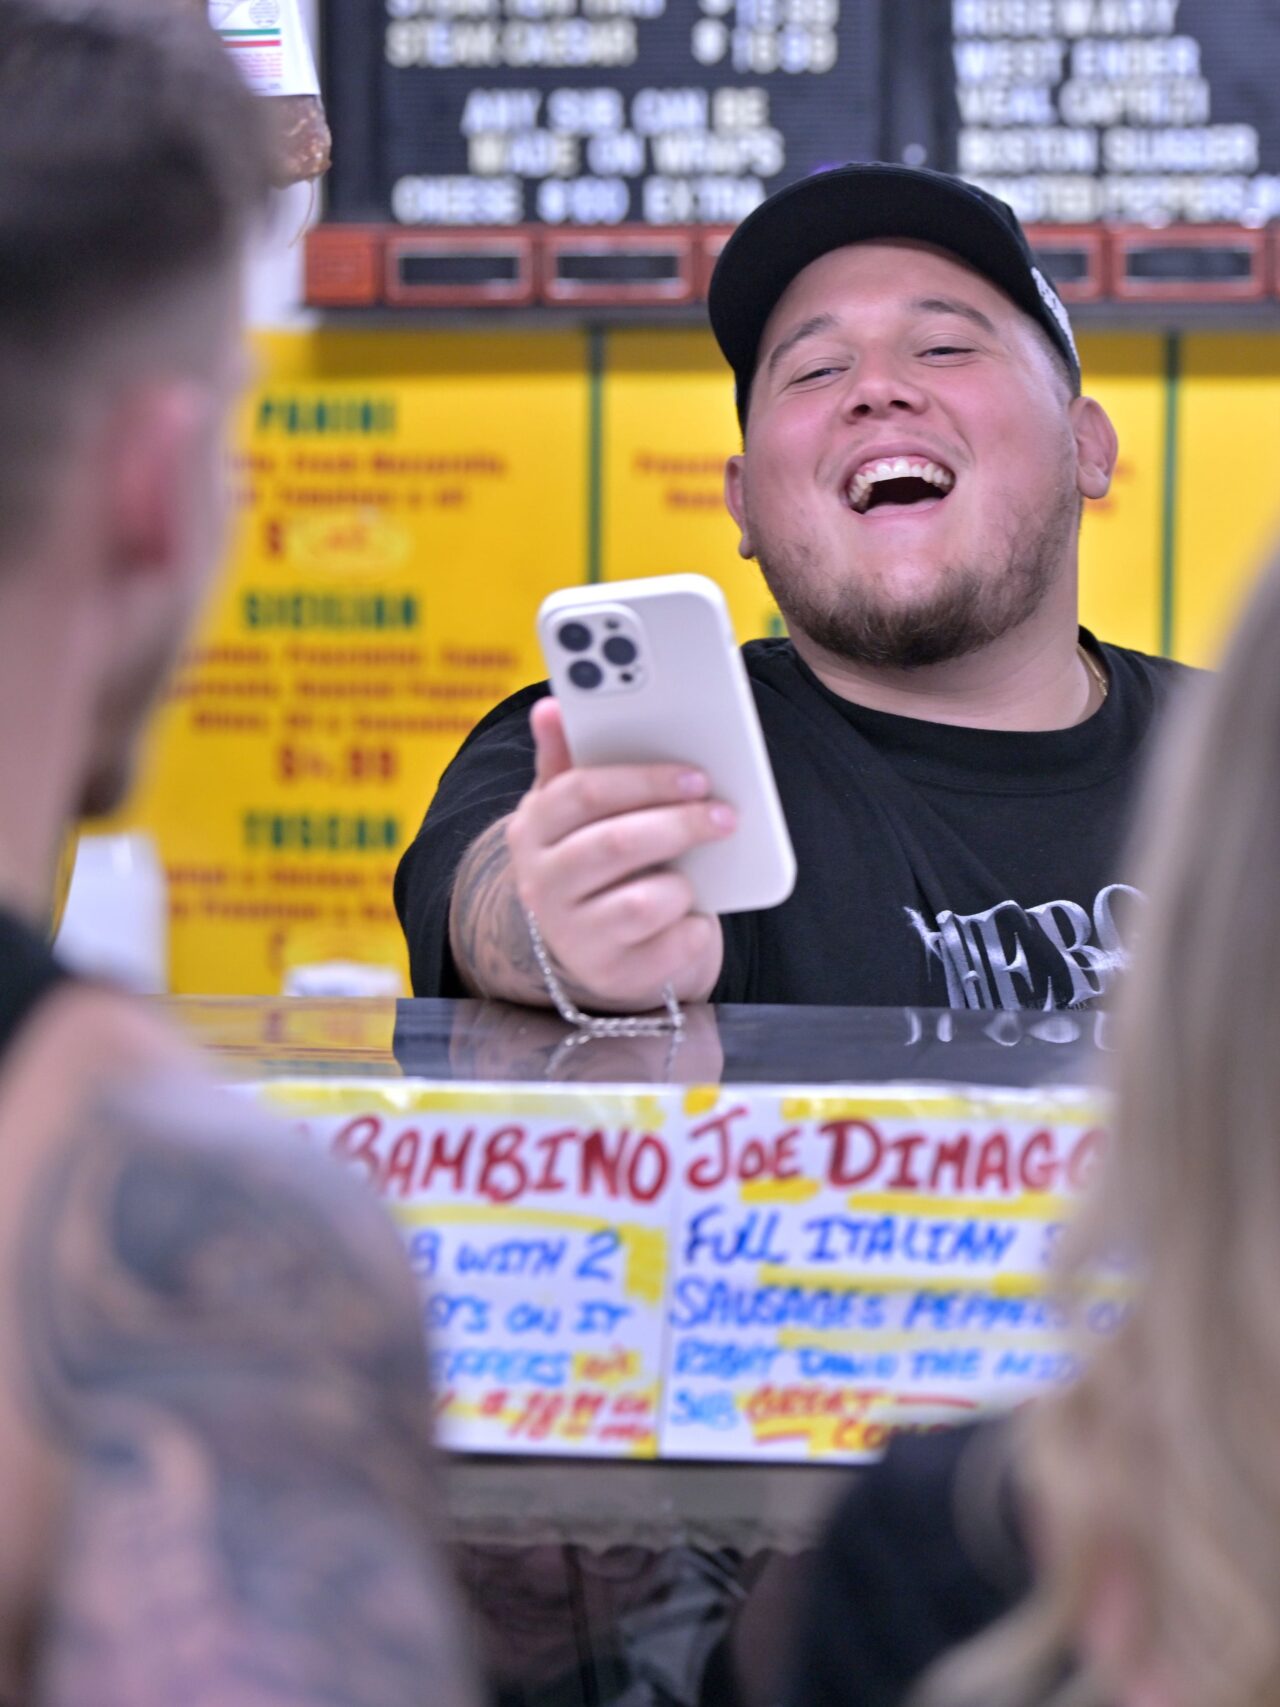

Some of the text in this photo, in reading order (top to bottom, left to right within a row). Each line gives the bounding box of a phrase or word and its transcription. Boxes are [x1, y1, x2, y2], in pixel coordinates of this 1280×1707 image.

[334, 1113, 670, 1206] BAMBINO
[455, 1236, 567, 1277] WITH
[804, 1213, 1015, 1265] ITALIAN
